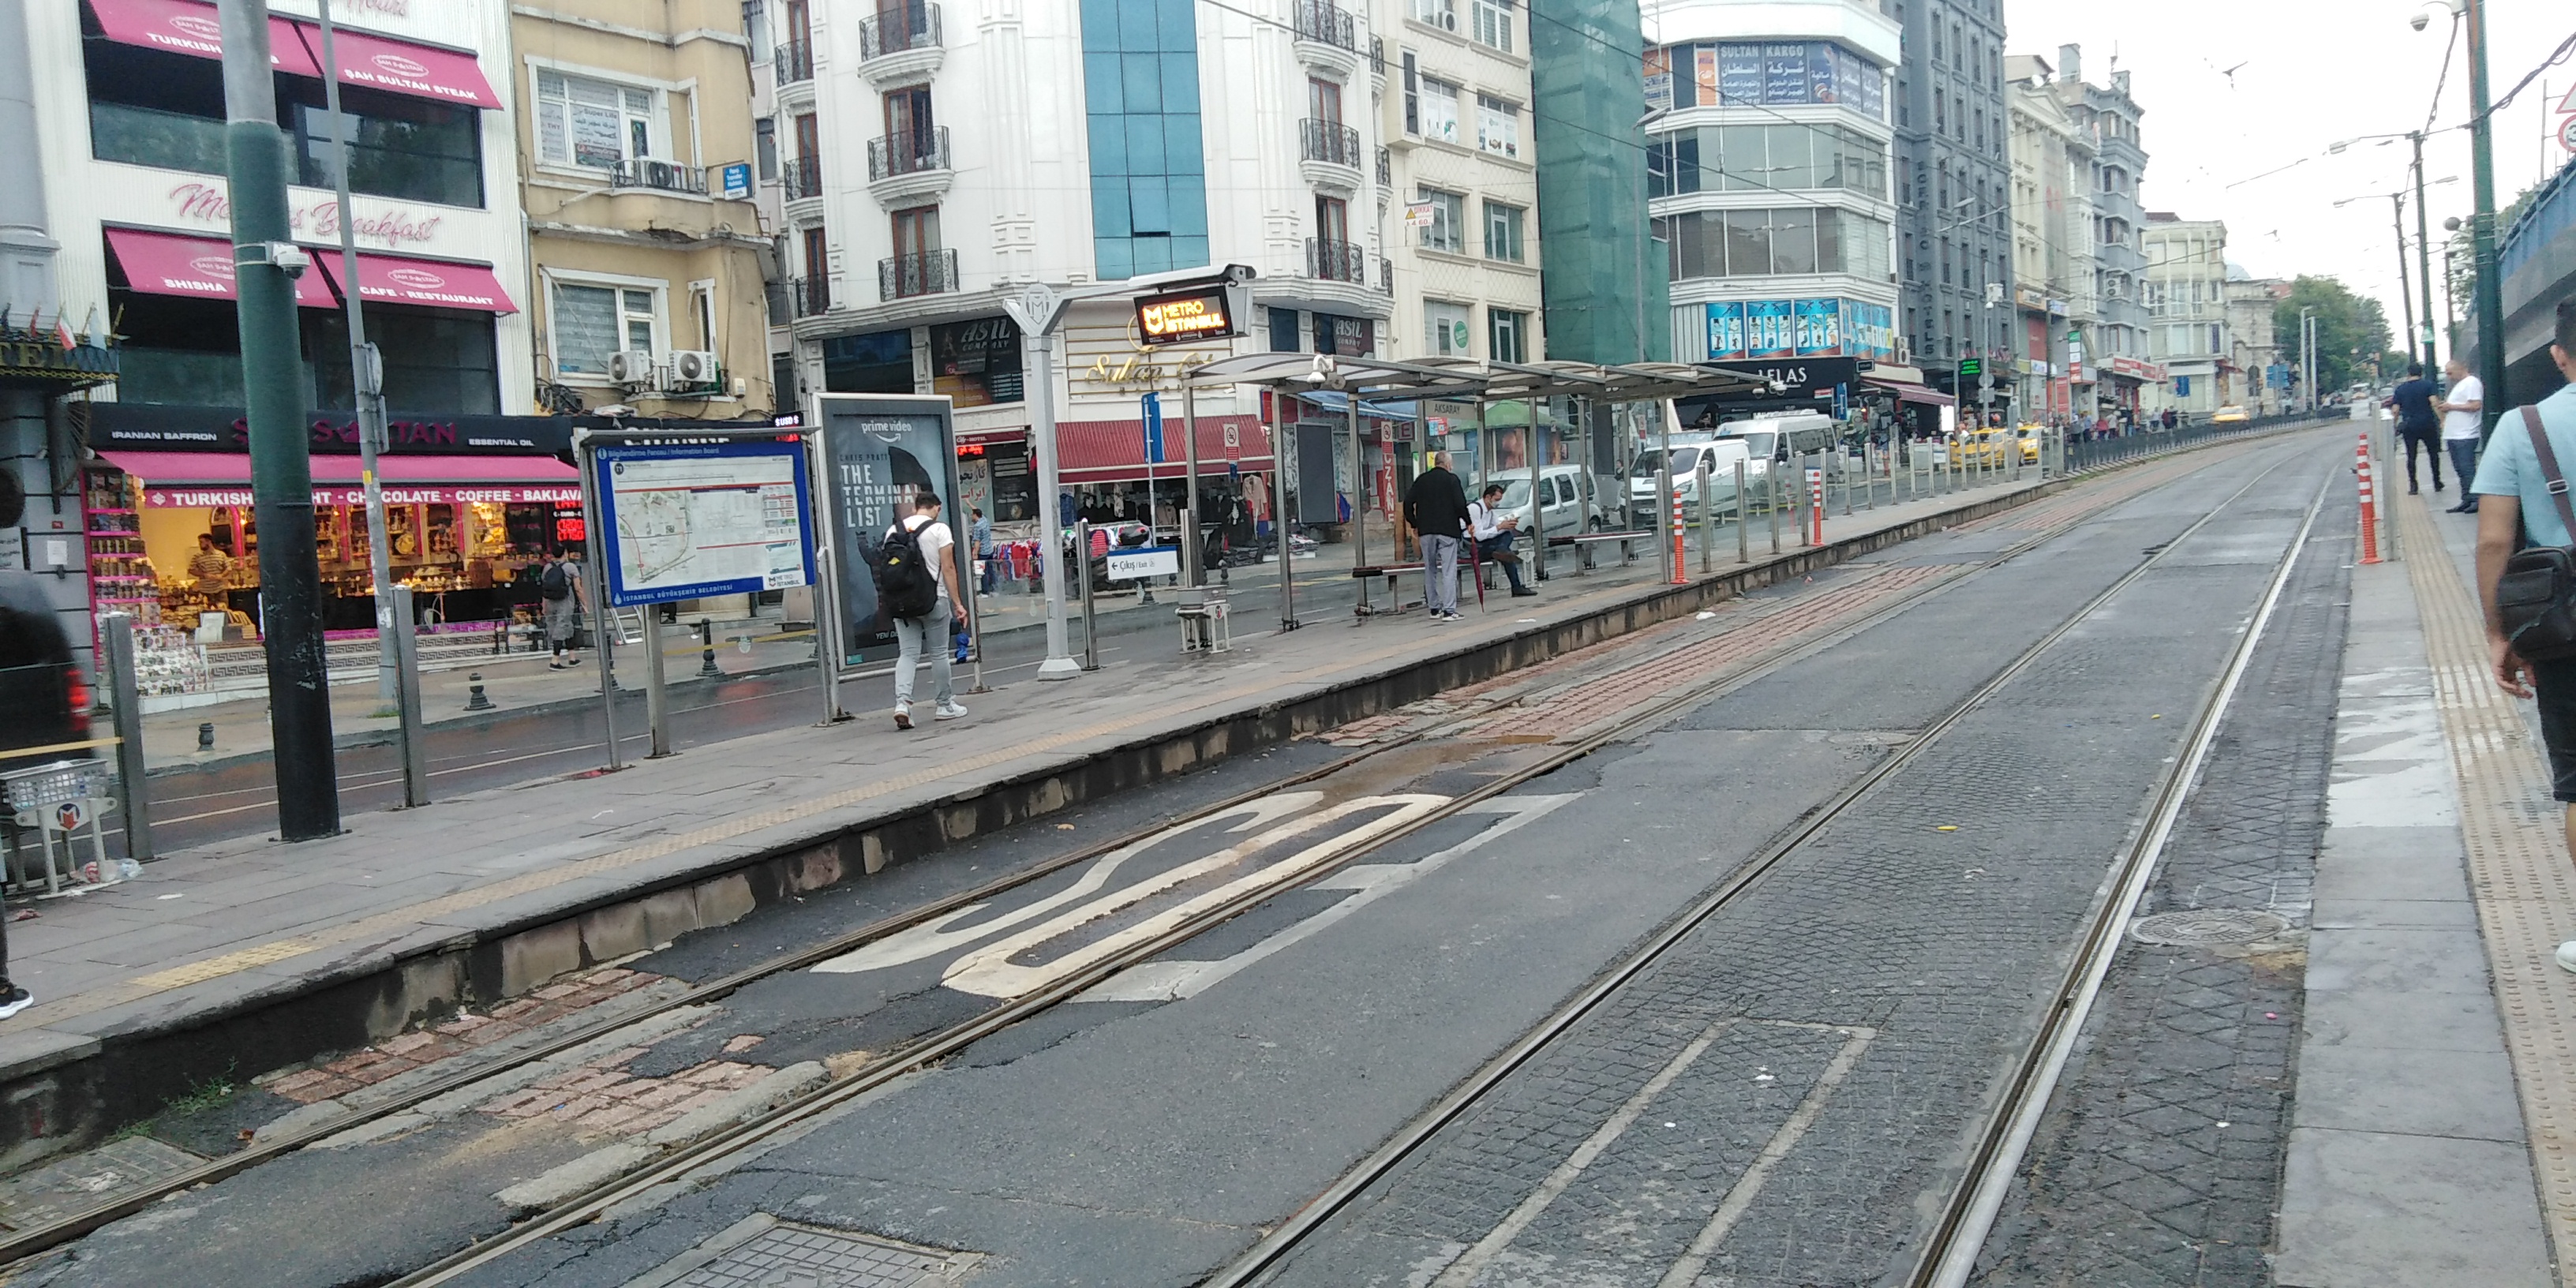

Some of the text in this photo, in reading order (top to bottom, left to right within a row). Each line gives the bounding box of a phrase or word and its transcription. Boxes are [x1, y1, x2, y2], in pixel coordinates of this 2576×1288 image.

[146, 32, 223, 54] TURKISH
[1720, 45, 1804, 58] SULTAN KARGO
[376, 74, 431, 92] SULTAN
[433, 85, 478, 100] STEAK
[310, 201, 440, 245] Beakfast
[163, 279, 227, 293] SHISHA
[360, 286, 398, 298] CAFE
[407, 290, 494, 305] RESTAURANT
[1162, 301, 1204, 318] METRO
[1335, 320, 1363, 338] ASIL
[1434, 403, 1460, 414] AKSARAY
[861, 420, 912, 434] prime video
[111, 431, 217, 441] IRANIAN SAFFRON
[469, 438, 536, 447] ESSENTIAL OIL
[841, 464, 873, 485] THE
[172, 492, 254, 506] TURKISH
[347, 490, 440, 504] CHCOLATE
[455, 489, 511, 502] COFFEE
[847, 507, 882, 528] LIST
[1119, 560, 1135, 572] Çıkış
